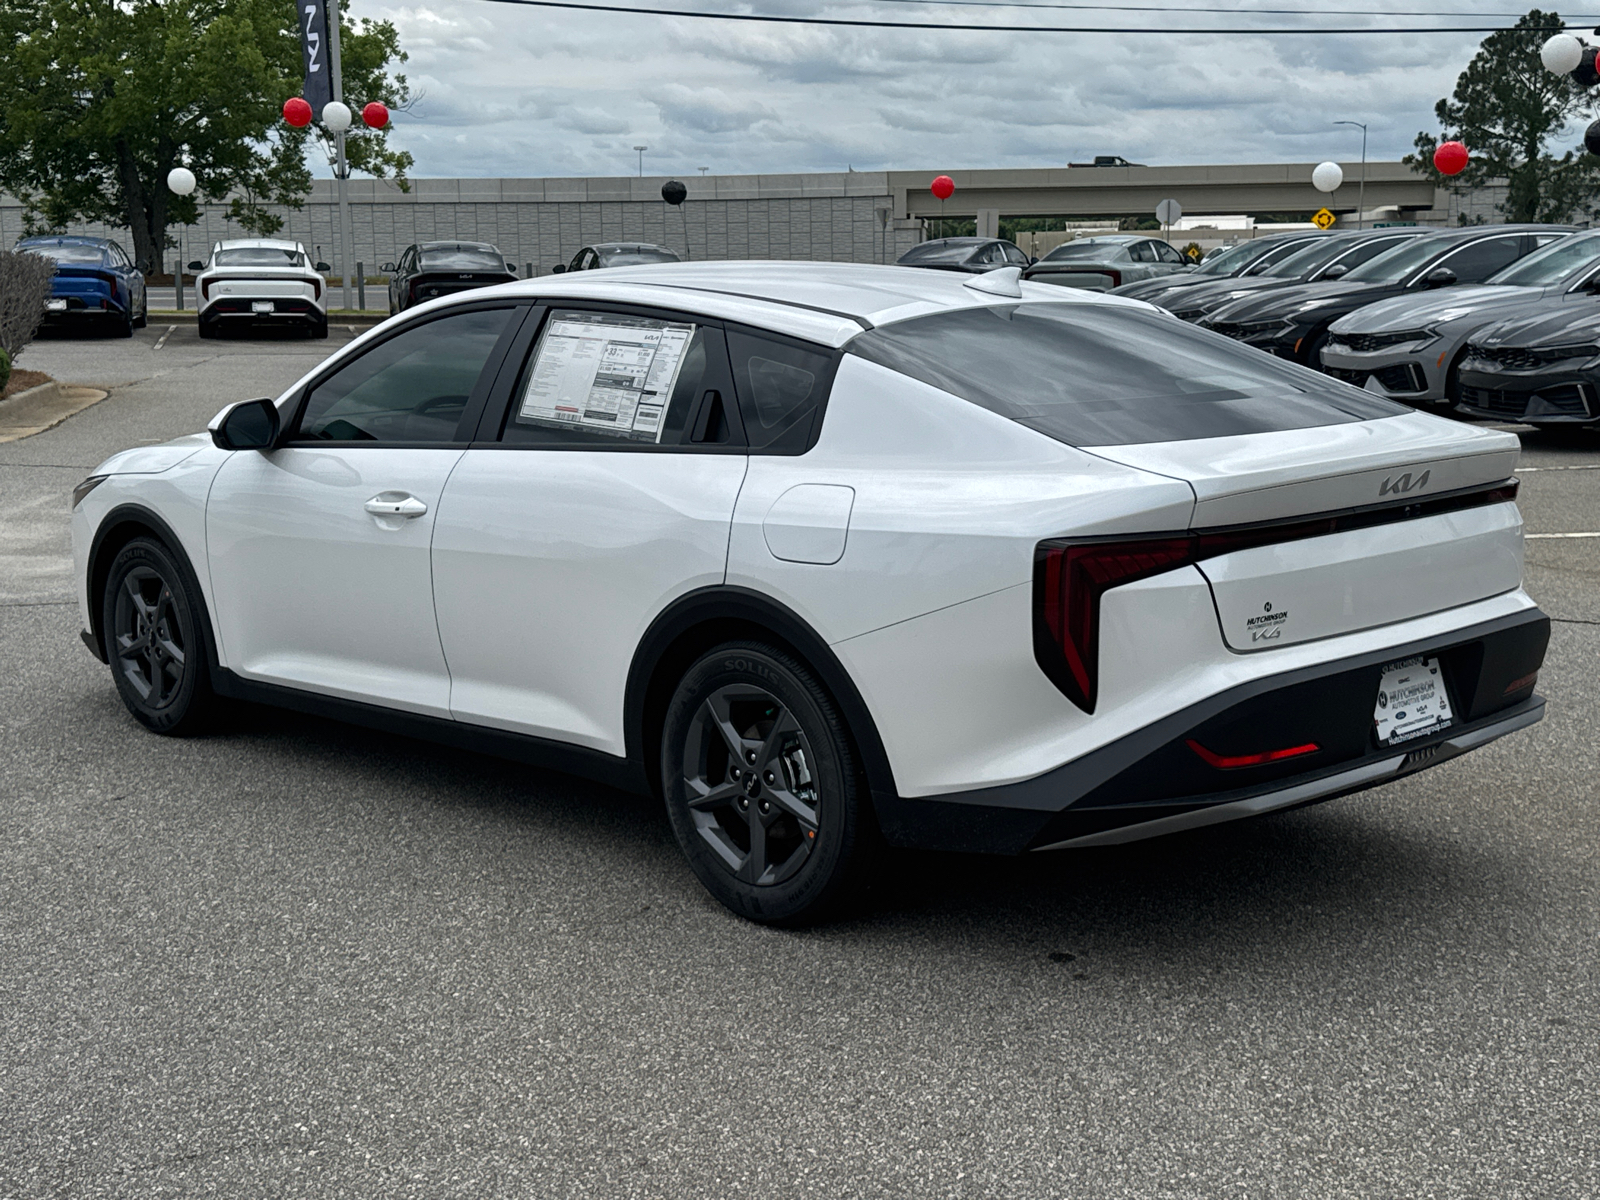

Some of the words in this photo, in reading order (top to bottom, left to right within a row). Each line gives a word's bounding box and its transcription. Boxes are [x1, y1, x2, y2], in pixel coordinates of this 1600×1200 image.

[1379, 469, 1431, 496] KIA
[1247, 611, 1288, 626] HUTCHINSON
[1252, 626, 1281, 642] K4
[724, 659, 779, 685] SOLUS
[1389, 680, 1435, 703] HUTCHINSON
[1391, 697, 1420, 710] AUTOMOTIVE
[1420, 691, 1435, 702] GROUP
